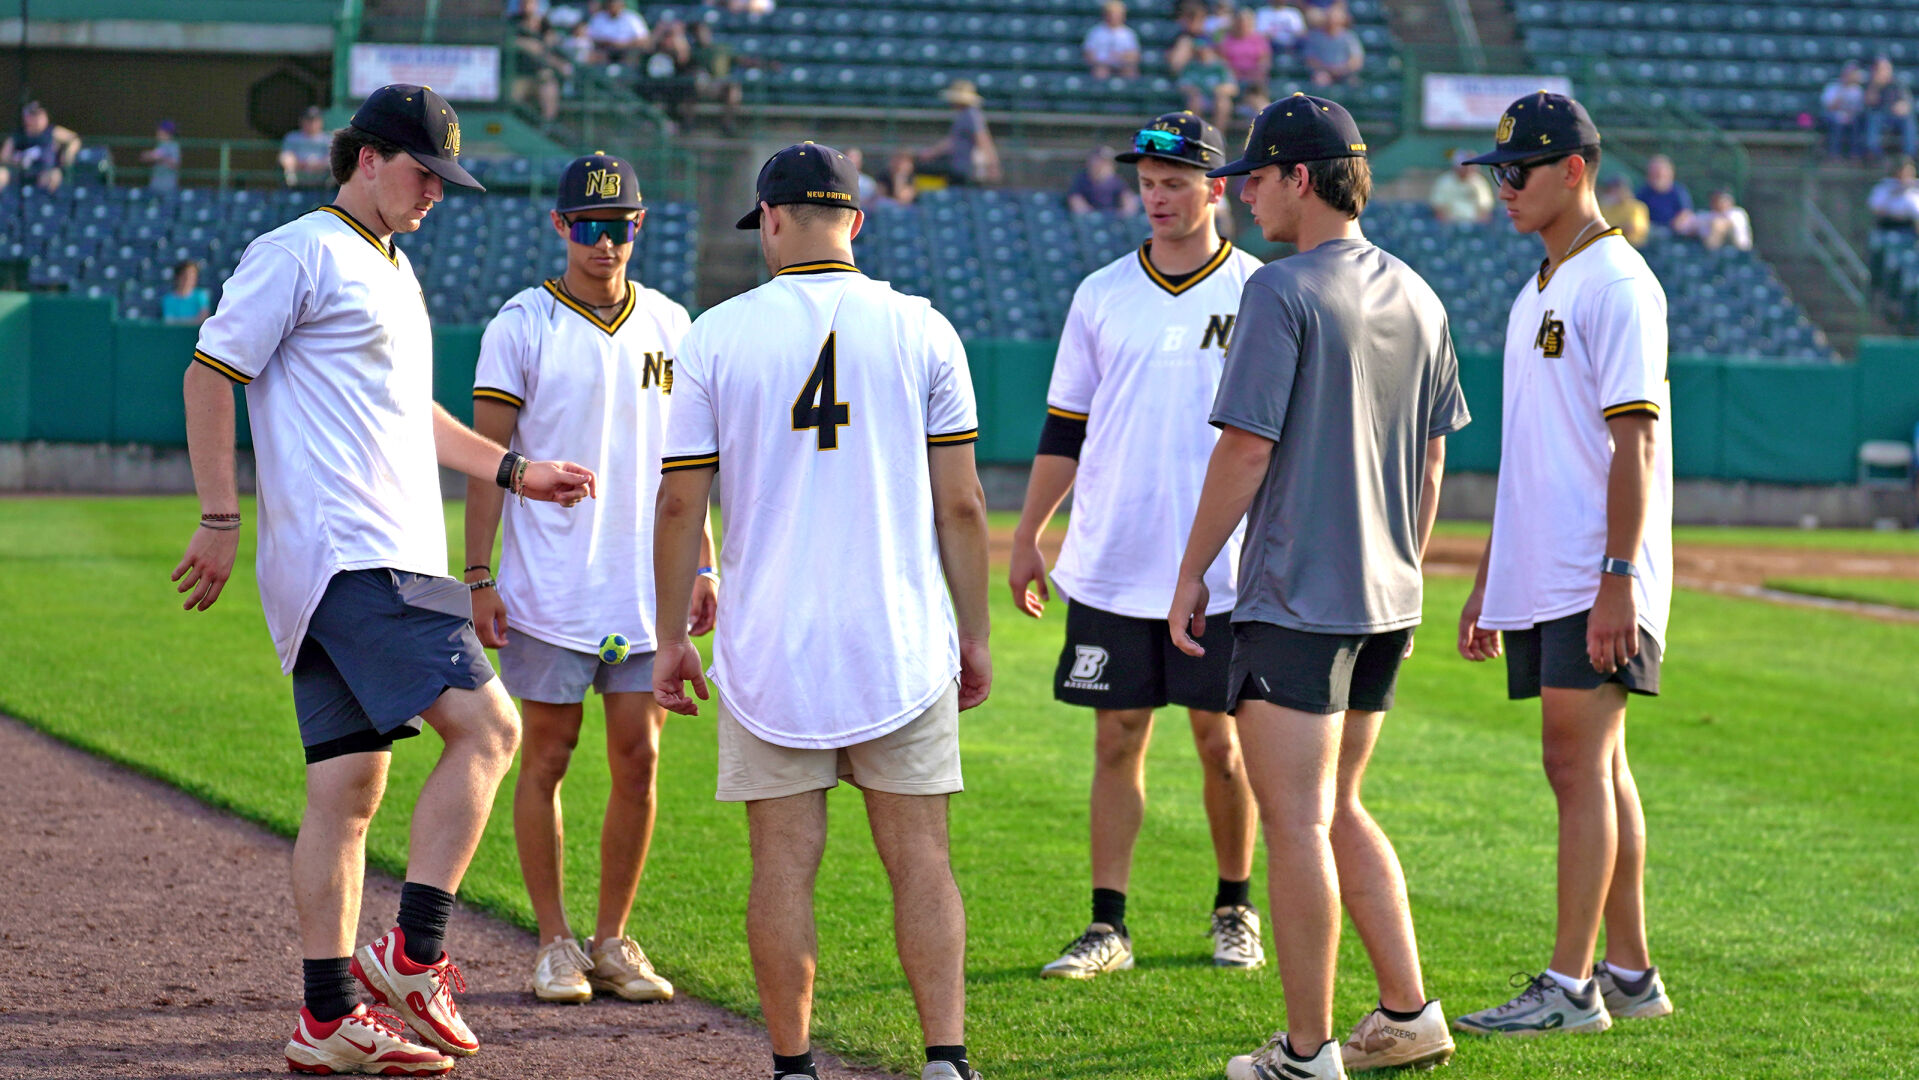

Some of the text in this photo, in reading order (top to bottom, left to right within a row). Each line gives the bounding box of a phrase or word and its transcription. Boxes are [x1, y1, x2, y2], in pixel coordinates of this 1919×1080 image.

[1540, 134, 1551, 144] Z
[1268, 144, 1279, 156] Z
[585, 168, 621, 199] NB
[806, 190, 852, 202] NEW BRITAIN
[1200, 314, 1236, 358] N
[791, 330, 850, 451] 4
[1069, 645, 1109, 683] B
[1063, 680, 1110, 690] BASEBALL
